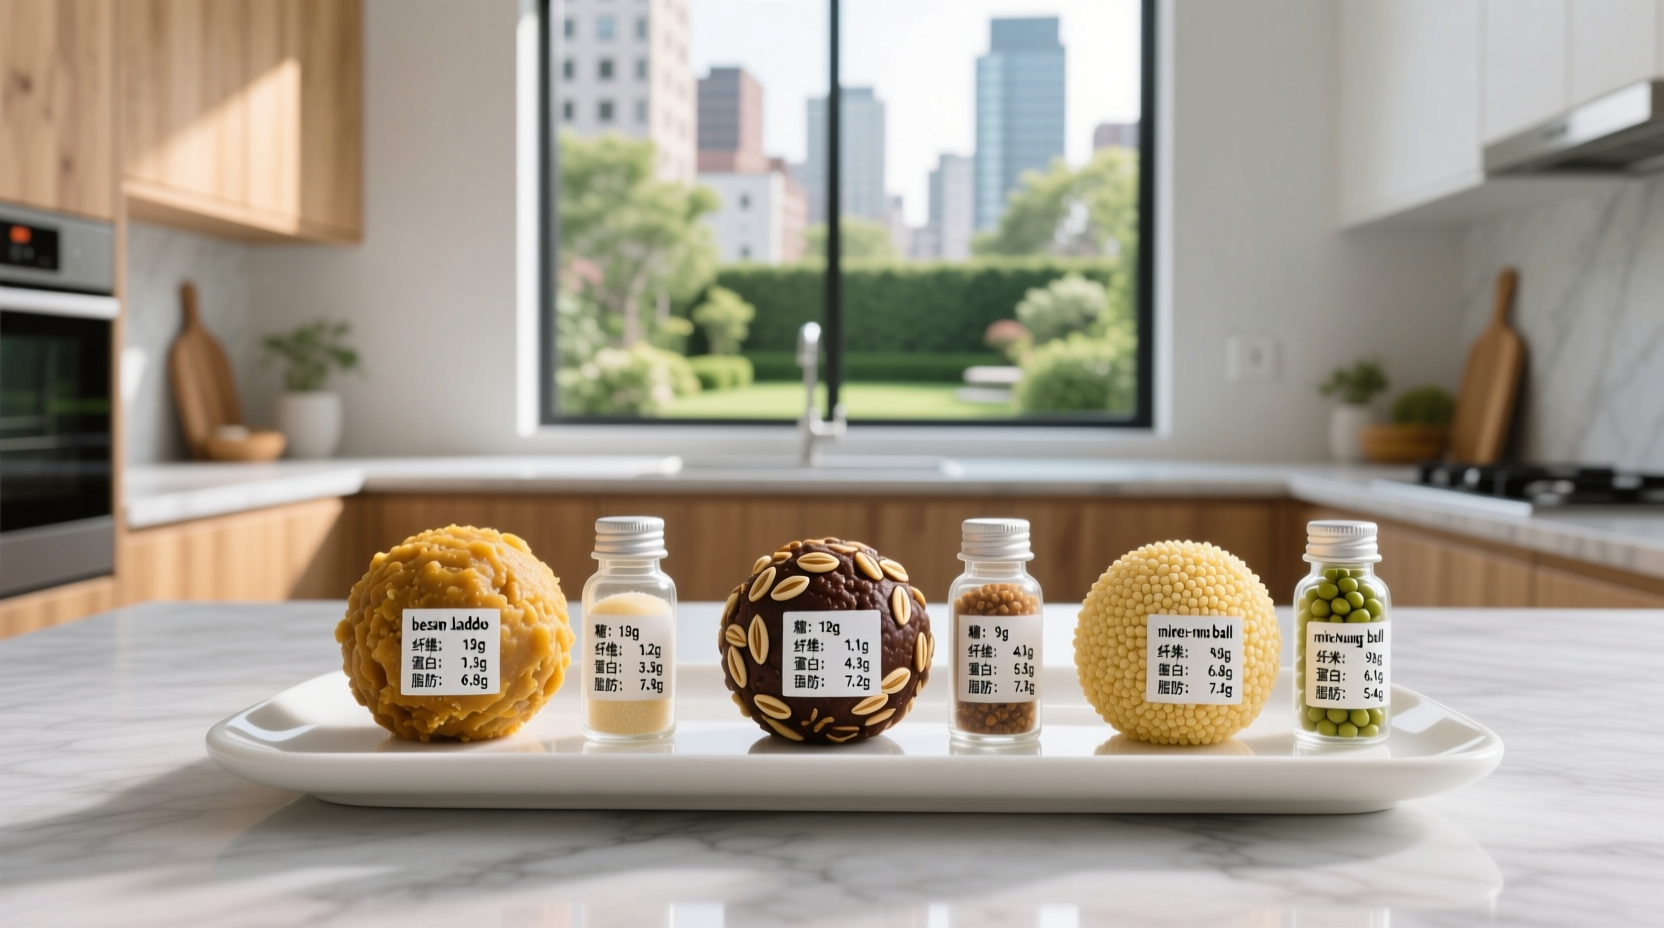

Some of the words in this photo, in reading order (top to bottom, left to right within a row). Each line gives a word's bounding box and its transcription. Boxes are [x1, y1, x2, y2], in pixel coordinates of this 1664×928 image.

[619, 625, 639, 641] 19g
[995, 626, 1008, 641] 9g
[1213, 624, 1233, 639] ball
[463, 638, 485, 653] 19g
[639, 643, 661, 658] 1.2g
[845, 638, 868, 654] 1.1g
[845, 675, 870, 690] 7.2g
